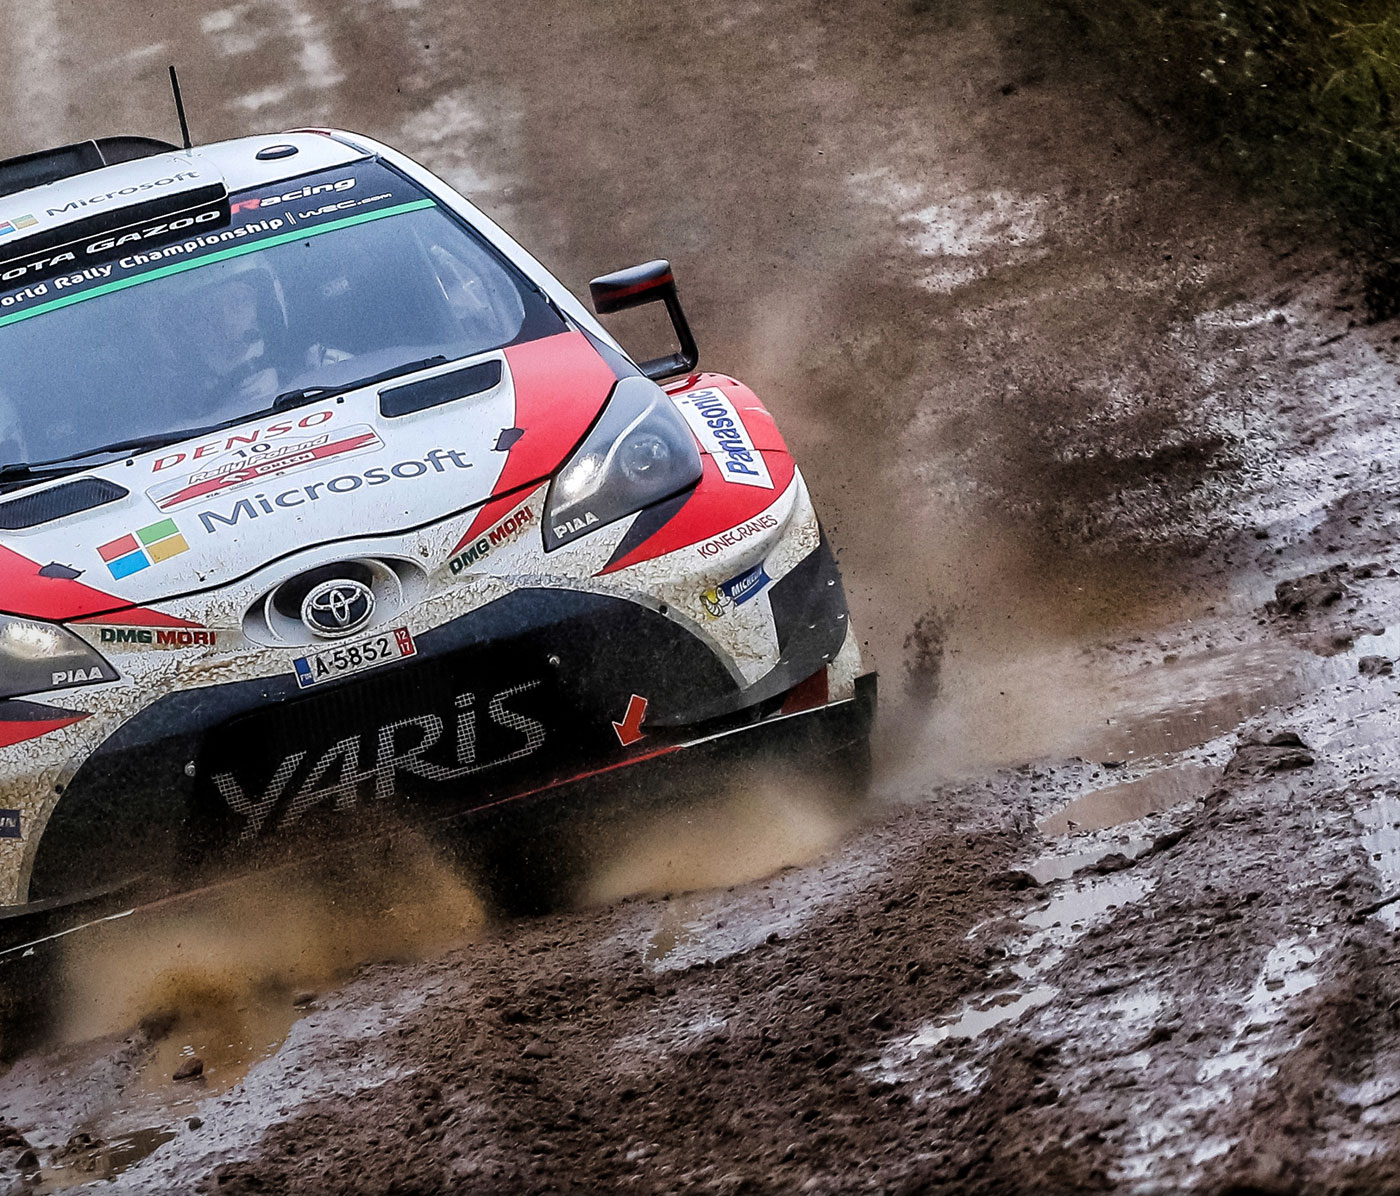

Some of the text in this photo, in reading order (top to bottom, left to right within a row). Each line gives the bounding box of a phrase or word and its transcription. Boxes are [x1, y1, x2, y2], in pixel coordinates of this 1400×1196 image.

[46, 170, 200, 217] Microsoft
[86, 209, 221, 254] GAZOO
[230, 176, 357, 215] Racing
[53, 264, 113, 291] Rally
[118, 216, 285, 270] Championship
[151, 410, 334, 474] DENSO
[231, 443, 272, 459] 10
[681, 389, 760, 477] Panasonic
[188, 433, 331, 485] Rally Poland
[259, 453, 311, 472] ORLEN
[197, 448, 474, 534] Microsoft
[449, 505, 534, 576] DMG MORI
[552, 511, 600, 541] PIAA
[696, 513, 779, 560] KONECRANES
[100, 628, 216, 646] DMG MORI
[396, 629, 408, 641] 12
[400, 641, 412, 653] 17
[51, 666, 103, 685] PIAA
